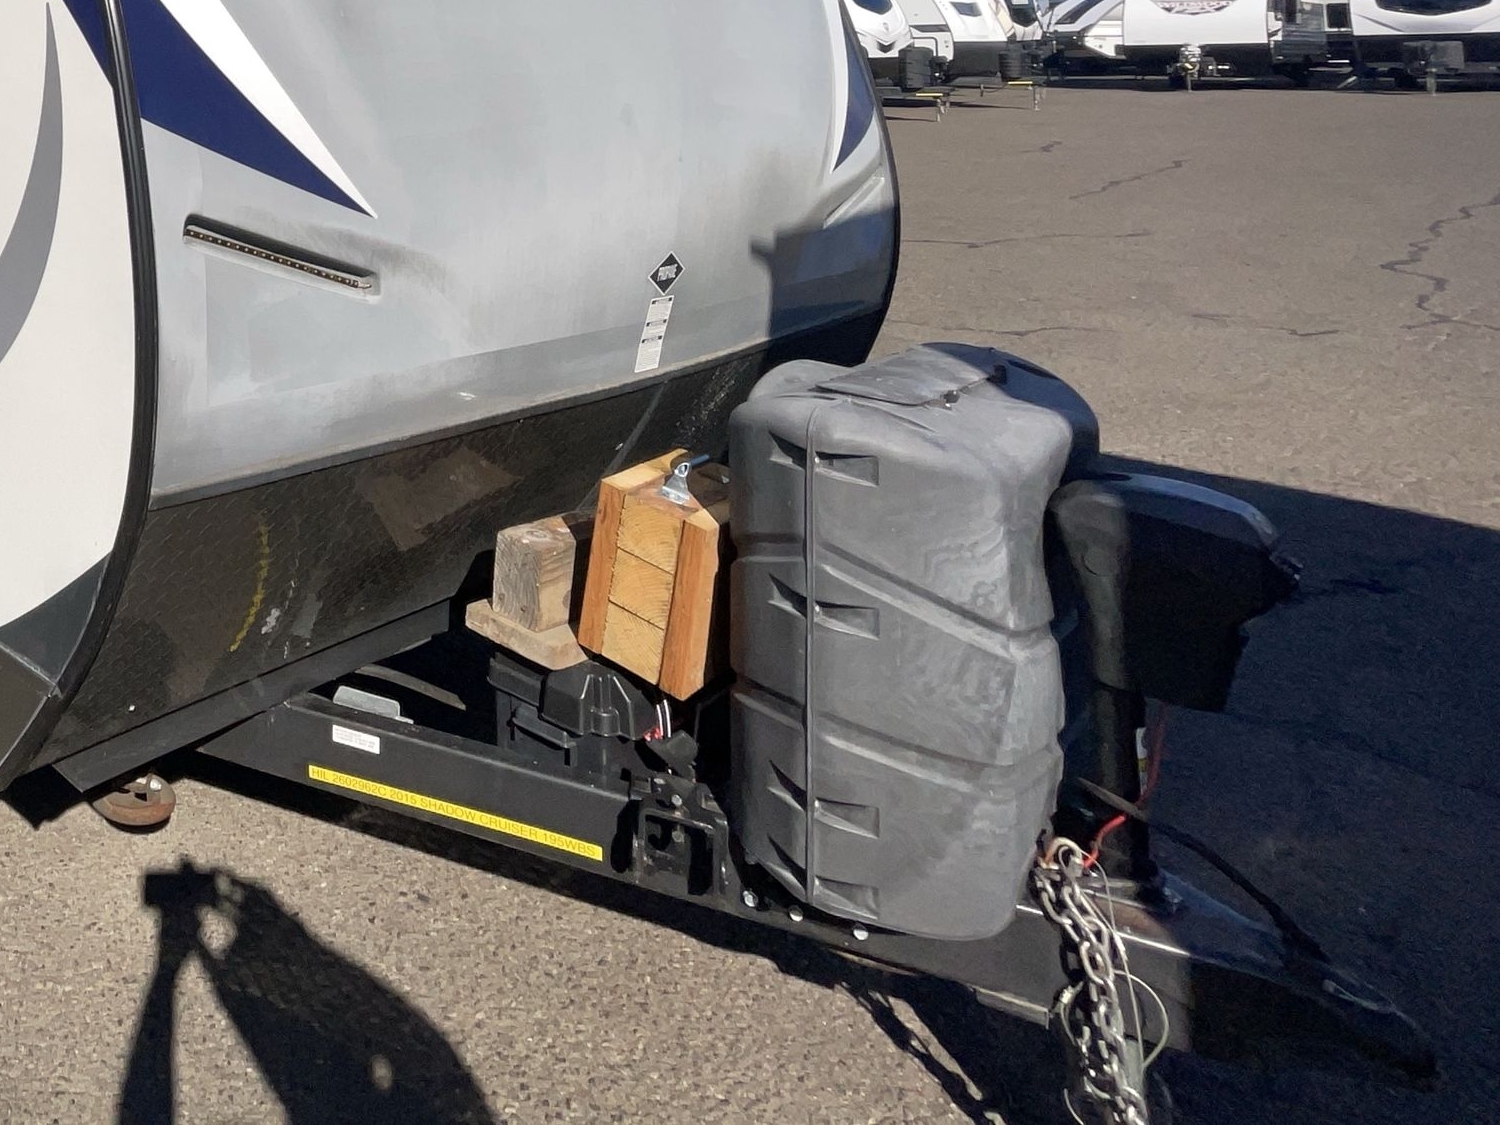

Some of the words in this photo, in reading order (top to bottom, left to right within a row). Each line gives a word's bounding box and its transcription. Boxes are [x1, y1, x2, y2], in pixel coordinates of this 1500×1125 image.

[311, 768, 329, 781] HIL
[389, 788, 418, 805] 2015
[420, 798, 477, 822] SHADOW
[479, 814, 538, 841] CRUISER
[542, 832, 596, 857] 195WBS
